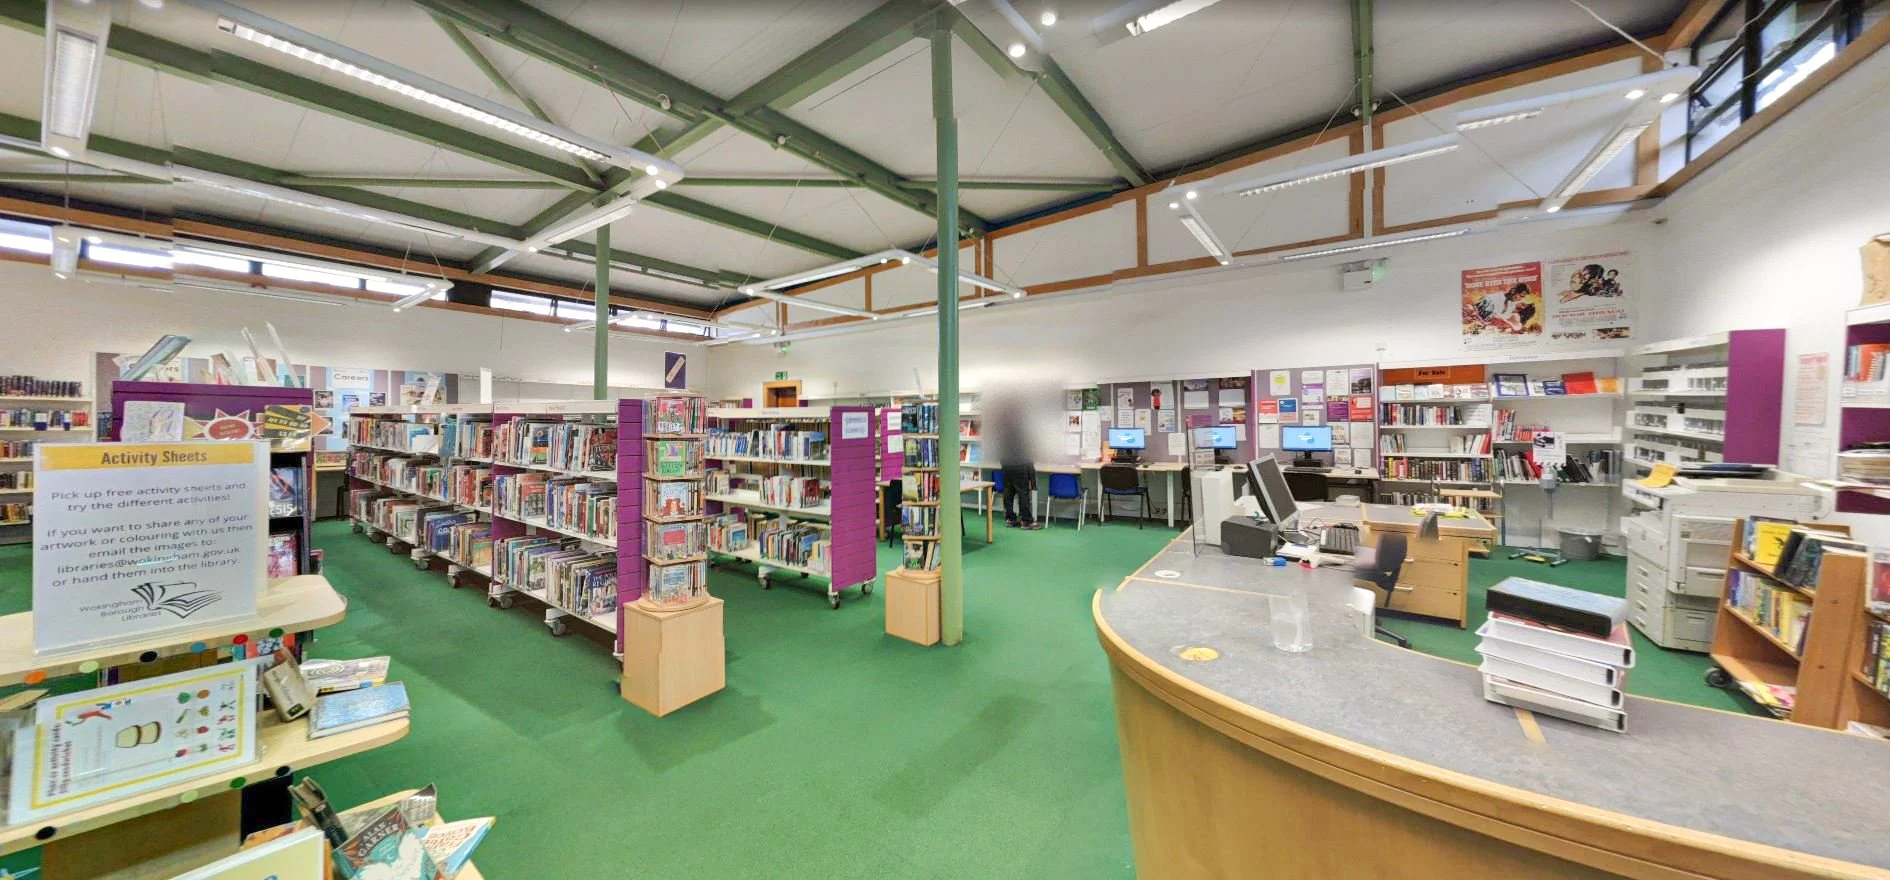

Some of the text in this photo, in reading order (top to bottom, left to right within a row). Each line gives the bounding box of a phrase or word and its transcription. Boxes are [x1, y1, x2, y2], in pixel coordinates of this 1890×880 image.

[101, 450, 208, 466] Activity Sheets
[51, 481, 246, 501] Pick up free activity sheets and
[68, 493, 231, 513] try the different activities!
[60, 526, 87, 538] you
[91, 523, 125, 535] want
[128, 521, 143, 531] to
[145, 518, 181, 530] share
[183, 516, 206, 526] any
[208, 514, 221, 524] of
[223, 513, 249, 524] your
[40, 523, 253, 551] artwork or colouring with us then
[89, 538, 217, 558] email the images to:
[57, 545, 240, 574] libraries@wokingham.gov.uk
[52, 558, 240, 588] or hand them into the library.
[79, 598, 143, 613] Wokingham
[100, 605, 144, 618] Borough
[121, 610, 162, 622] Libraries
[358, 822, 400, 858] GARNER
